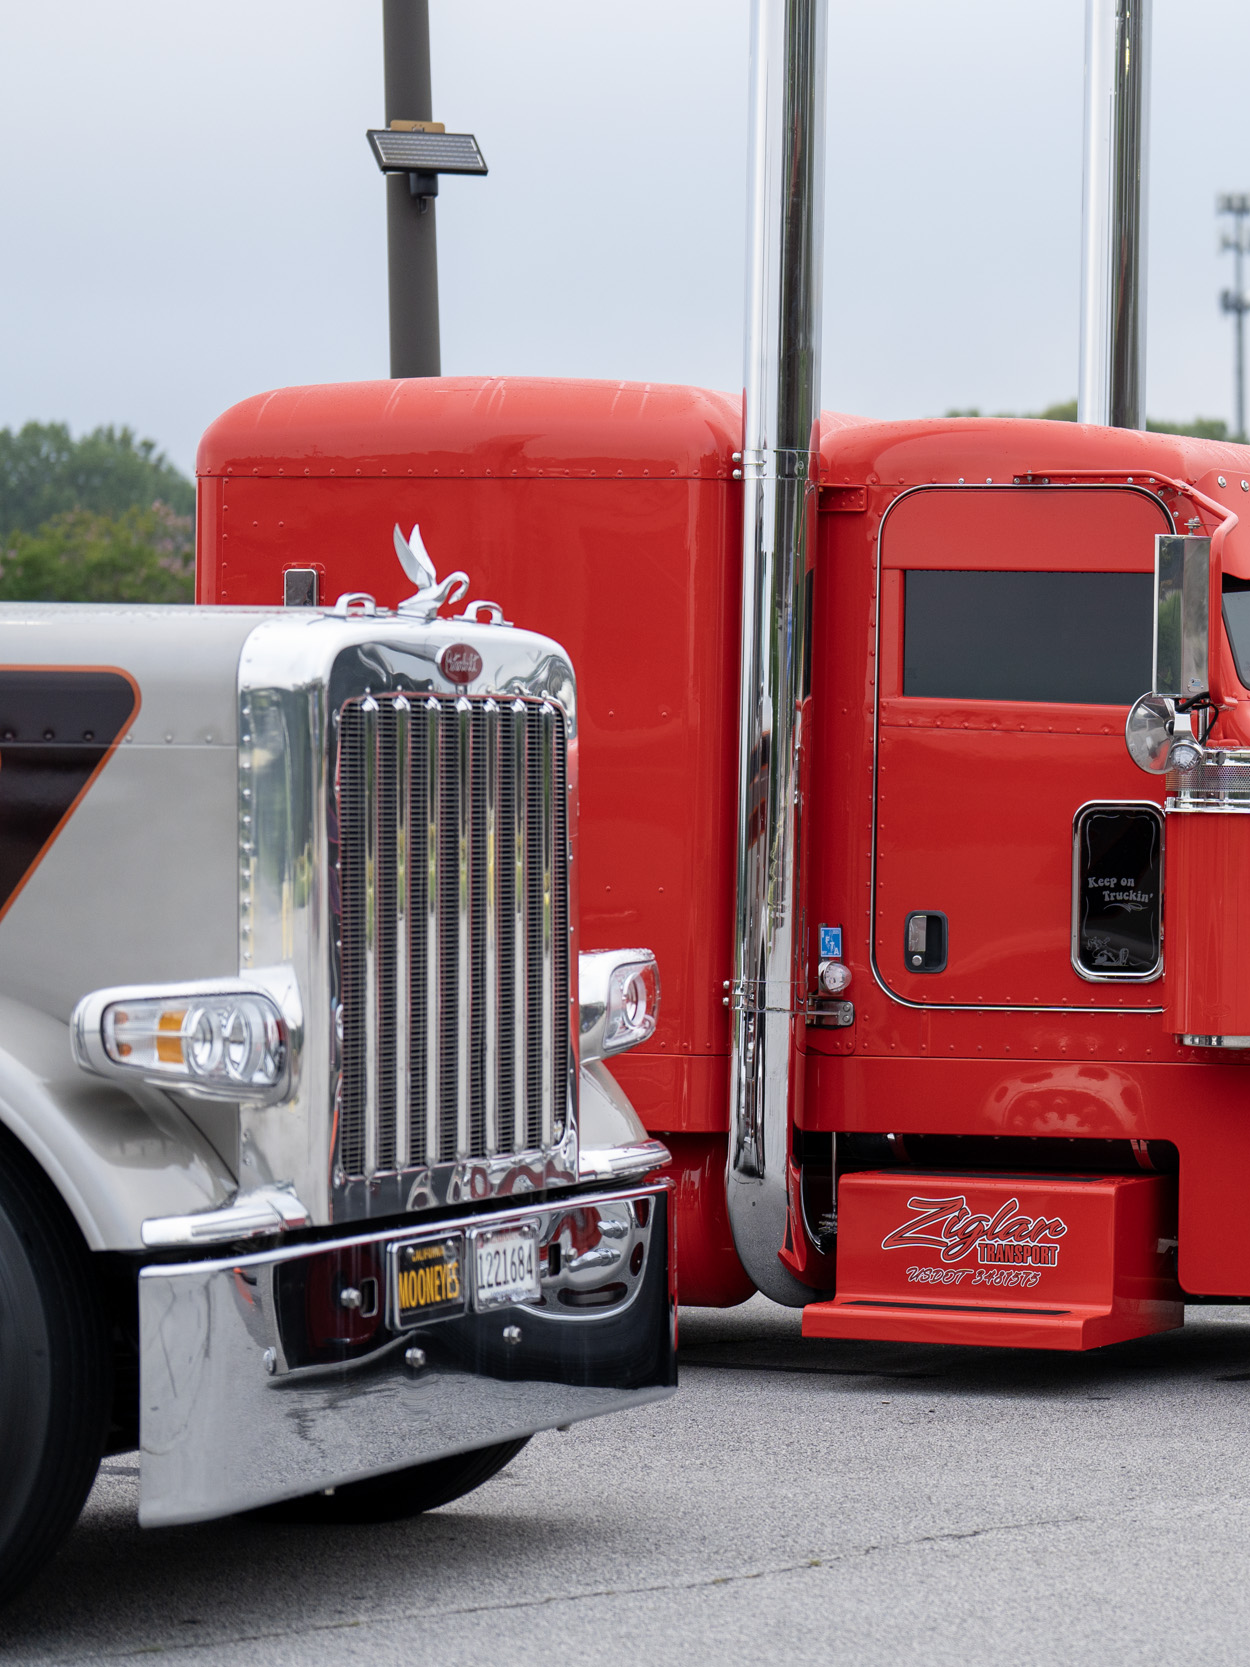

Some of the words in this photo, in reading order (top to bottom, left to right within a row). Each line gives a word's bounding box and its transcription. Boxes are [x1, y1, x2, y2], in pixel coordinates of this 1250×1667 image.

[1087, 877, 1117, 888] Keep
[1120, 877, 1135, 887] on
[1102, 890, 1154, 903] Truckin'
[977, 1242, 1060, 1267] TRANSPORT
[478, 1243, 534, 1289] 1221684
[906, 1266, 974, 1285] USDOT
[399, 1262, 460, 1309] MOONEYES
